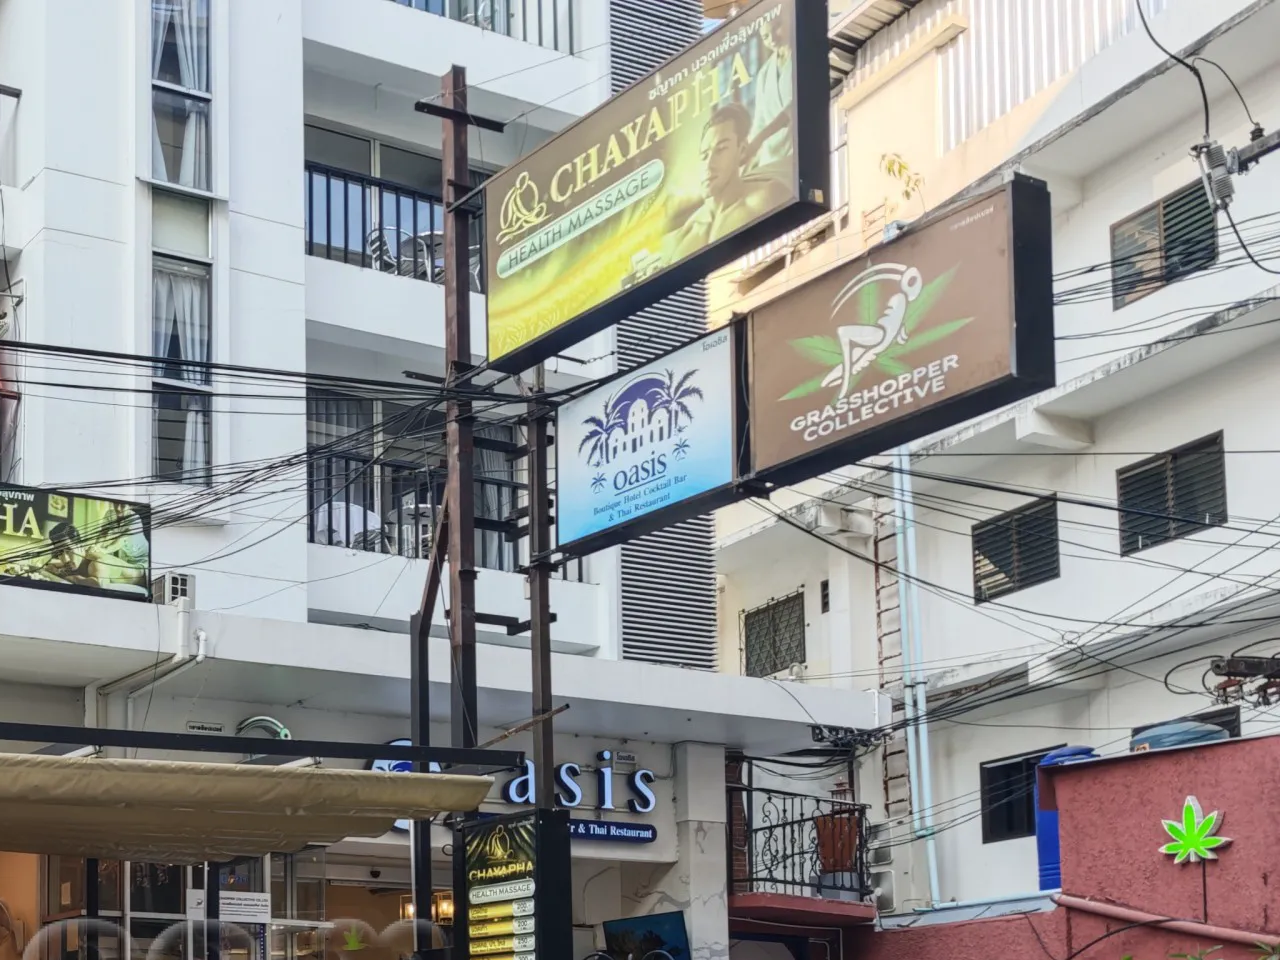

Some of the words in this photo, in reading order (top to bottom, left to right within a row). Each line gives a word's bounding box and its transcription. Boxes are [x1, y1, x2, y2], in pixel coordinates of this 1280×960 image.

[550, 52, 753, 203] CHAYAPHA
[508, 222, 562, 268] HEALTH
[569, 171, 650, 232] MASSAGE
[790, 354, 960, 431] GRASSHOPPER
[803, 375, 946, 442] COLLECTIVE
[613, 450, 667, 491] oasis
[593, 499, 622, 516] Boutique
[624, 491, 642, 504] Hotel
[643, 481, 671, 496] Cocktail
[674, 474, 688, 485] Bar
[618, 506, 632, 519] Thai
[634, 493, 671, 513] Restaurant
[578, 823, 586, 834] &
[589, 823, 608, 835] Thai
[610, 825, 653, 839] Restaurant
[469, 860, 534, 881] CHAYAPHA
[472, 889, 498, 899] HEALTH
[499, 883, 531, 896] MASSAGE
